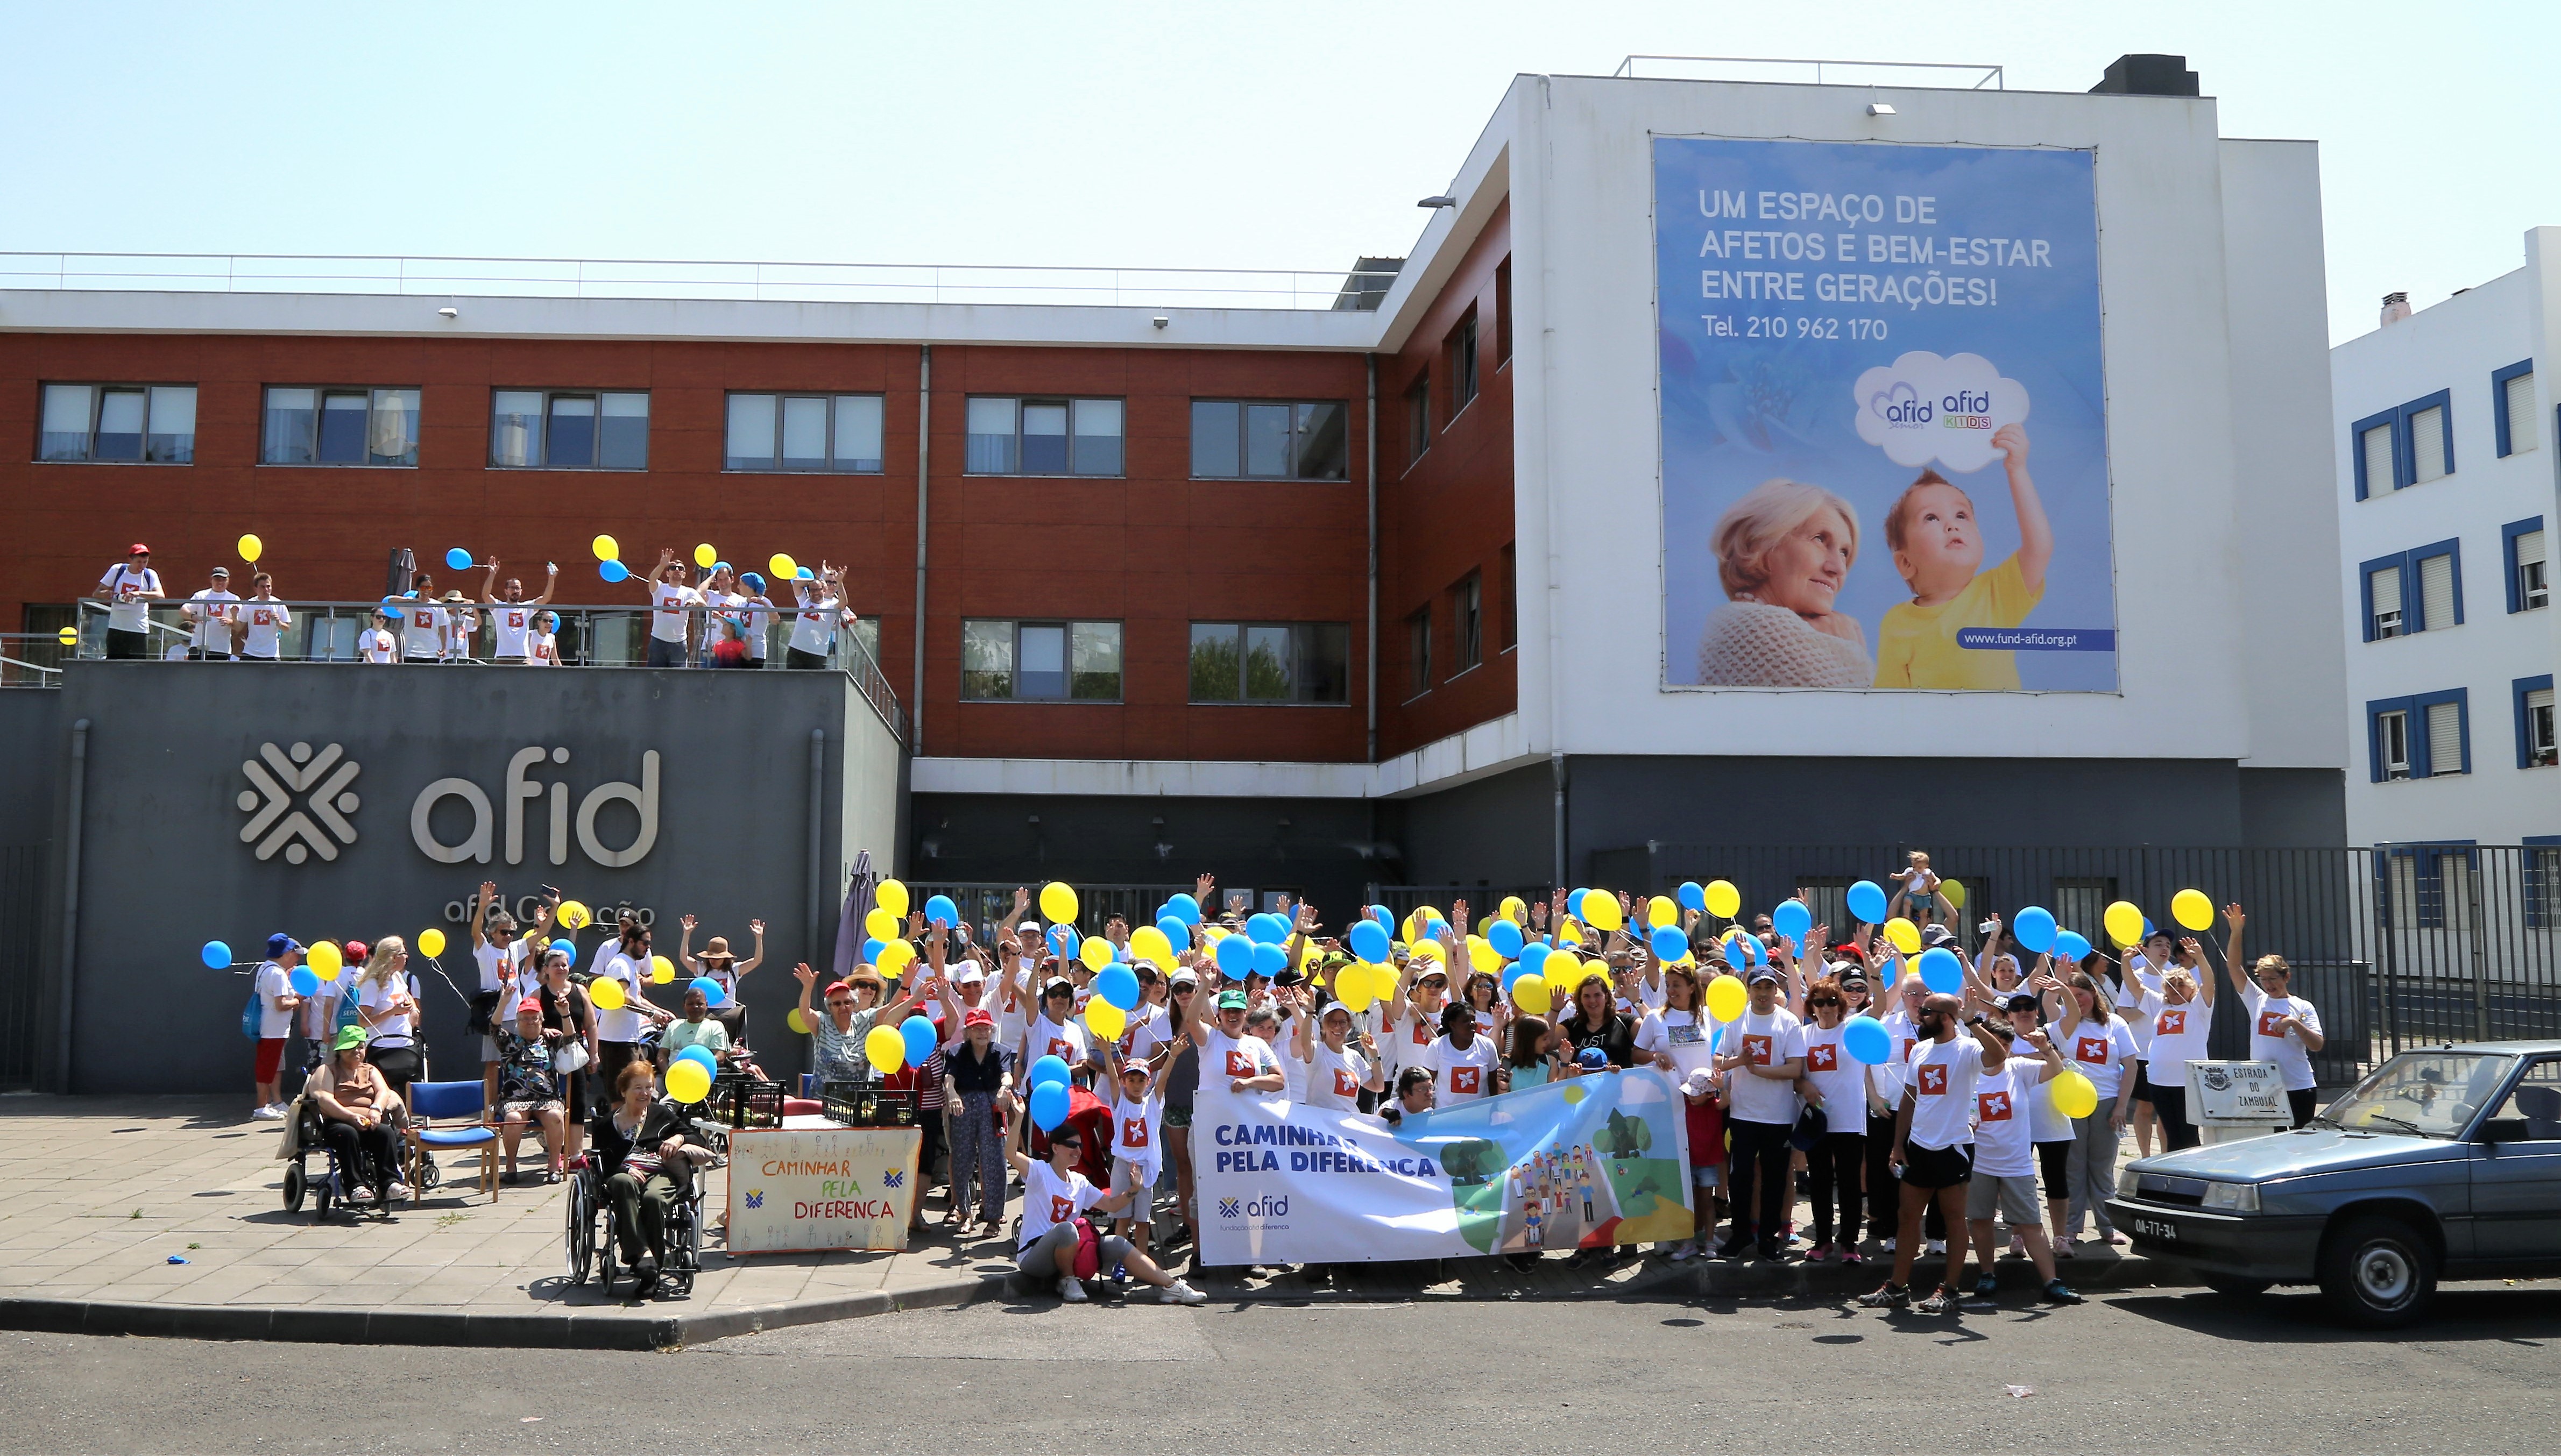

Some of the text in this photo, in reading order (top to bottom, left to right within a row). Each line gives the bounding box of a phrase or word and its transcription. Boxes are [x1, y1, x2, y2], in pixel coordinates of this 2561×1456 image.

[1699, 189, 1937, 229] UM ESPAÇO DE
[1699, 230, 2053, 268] AFETOS E BEM-ESTAR
[1701, 269, 1997, 311] ENTRE GERAÇÕES!
[1701, 314, 1888, 341] Tel. 210 962 170
[1886, 400, 1933, 423] afid
[1942, 390, 1990, 414] afid
[1945, 418, 1989, 428] KIDS
[1964, 633, 2077, 648] www.fund-afid.org.pt
[411, 745, 660, 868] afid
[444, 894, 506, 922] afd
[1575, 1034, 1606, 1049] JUST
[2233, 1068, 2268, 1079] ESTRADA
[2249, 1082, 2260, 1092] DO
[2238, 1096, 2278, 1107] ZAMBUJAL
[1215, 1124, 1358, 1152] CAMINHAR
[1216, 1150, 1279, 1173] PELA
[822, 1180, 862, 1198] PELA
[794, 1199, 895, 1220] DIFERENÇA
[1247, 1195, 1288, 1217] afid
